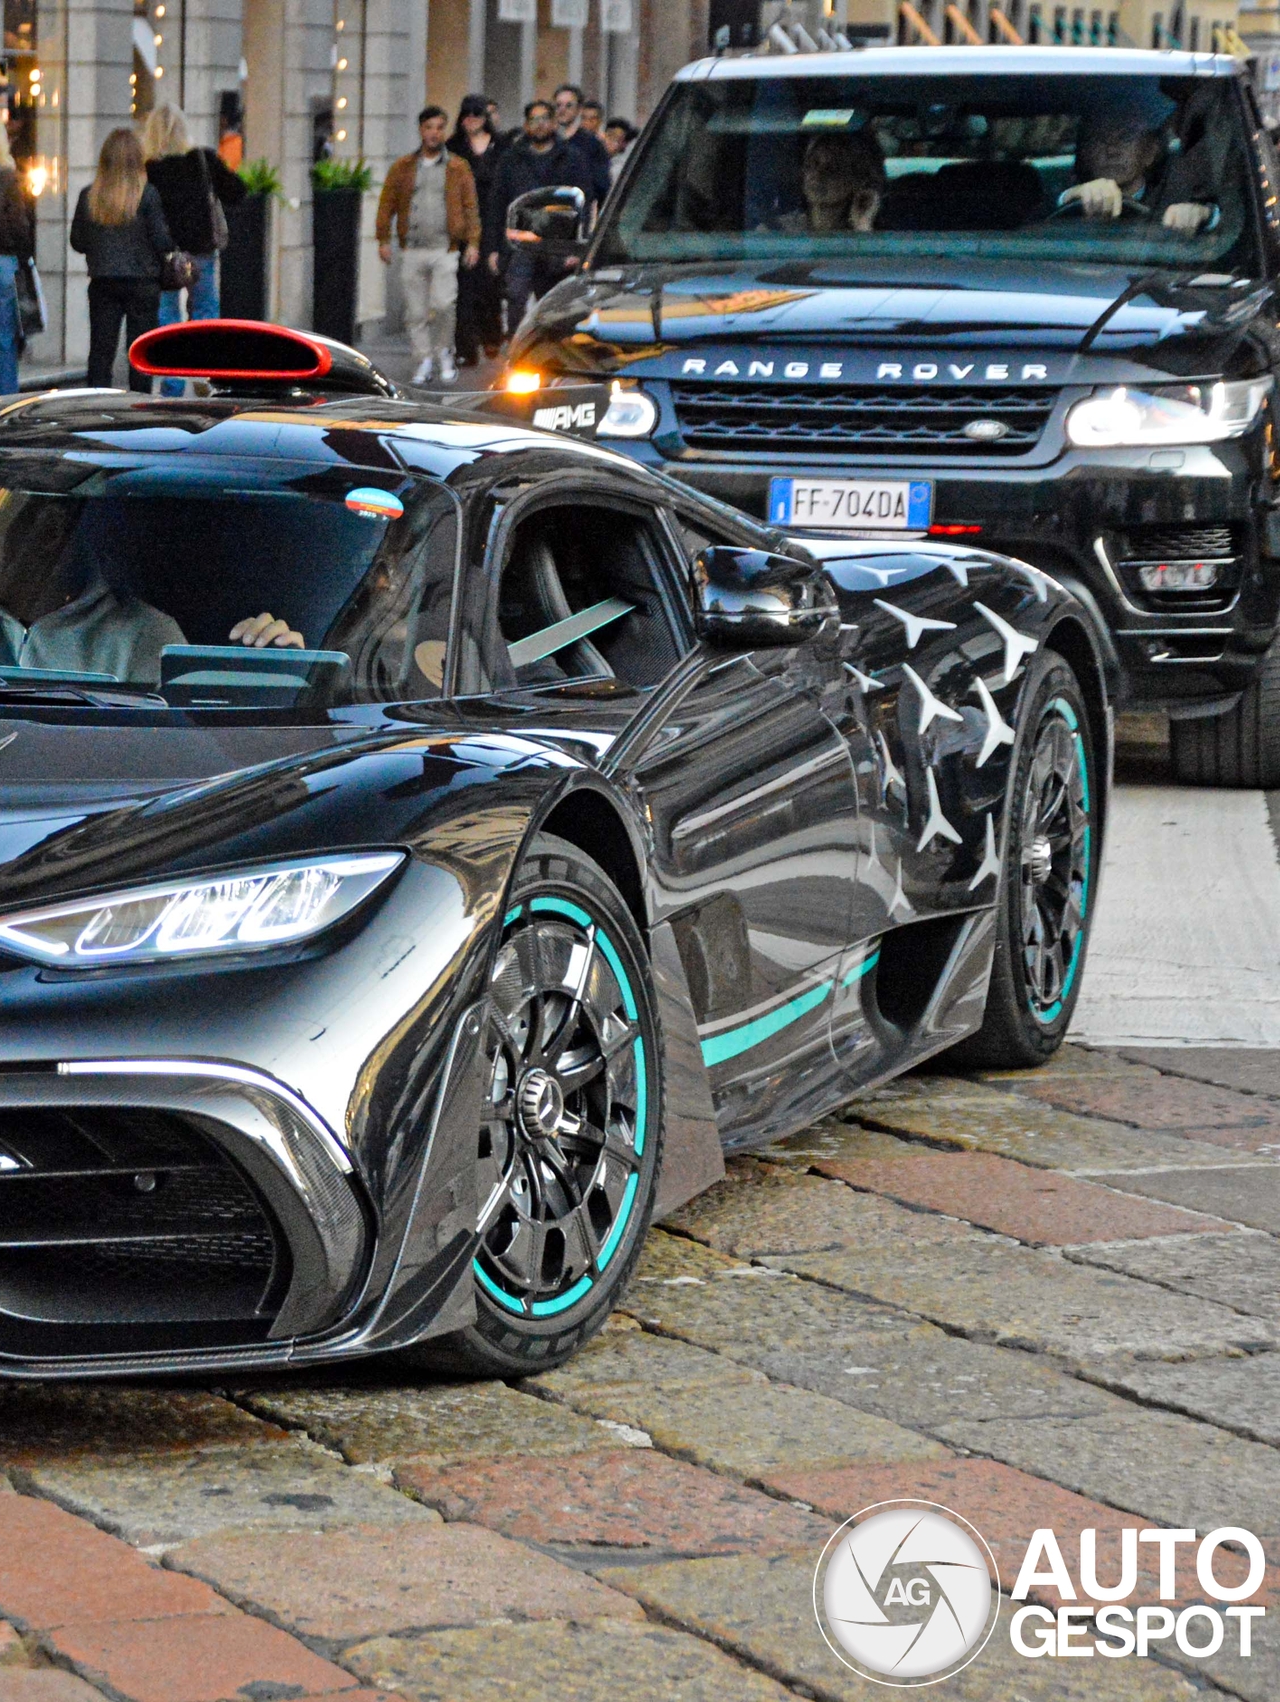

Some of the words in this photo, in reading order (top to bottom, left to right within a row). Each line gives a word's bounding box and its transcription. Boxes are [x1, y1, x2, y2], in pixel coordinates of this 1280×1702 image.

[681, 359, 843, 378] RANGE
[876, 362, 1048, 380] ROVER
[552, 402, 596, 431] AMG
